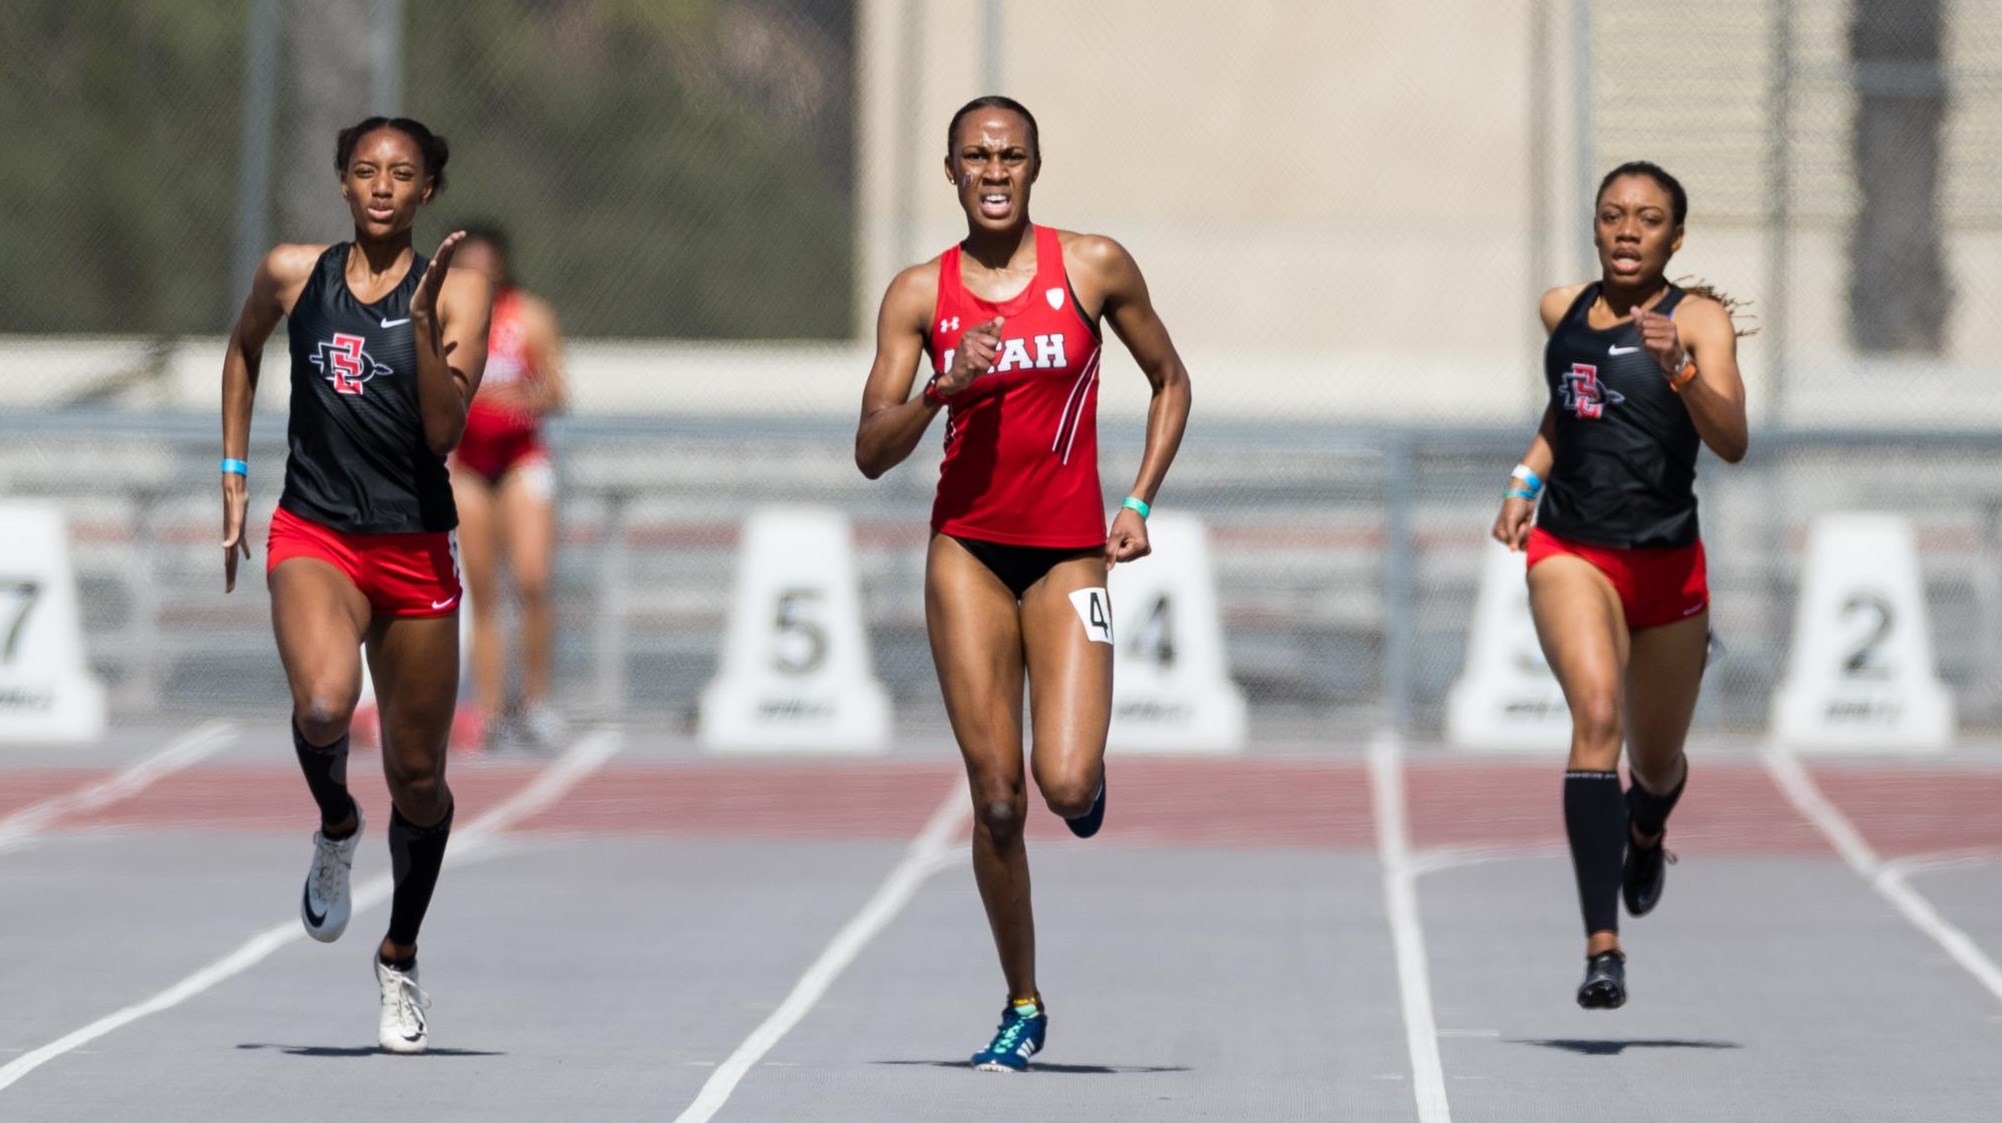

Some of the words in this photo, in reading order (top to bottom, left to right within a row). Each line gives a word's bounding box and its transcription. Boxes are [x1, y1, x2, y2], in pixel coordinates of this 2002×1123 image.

[943, 333, 1068, 374] AH
[773, 586, 831, 678] 5
[1090, 591, 1110, 640] 4
[1122, 592, 1177, 669] 4
[1838, 588, 1895, 680] 2
